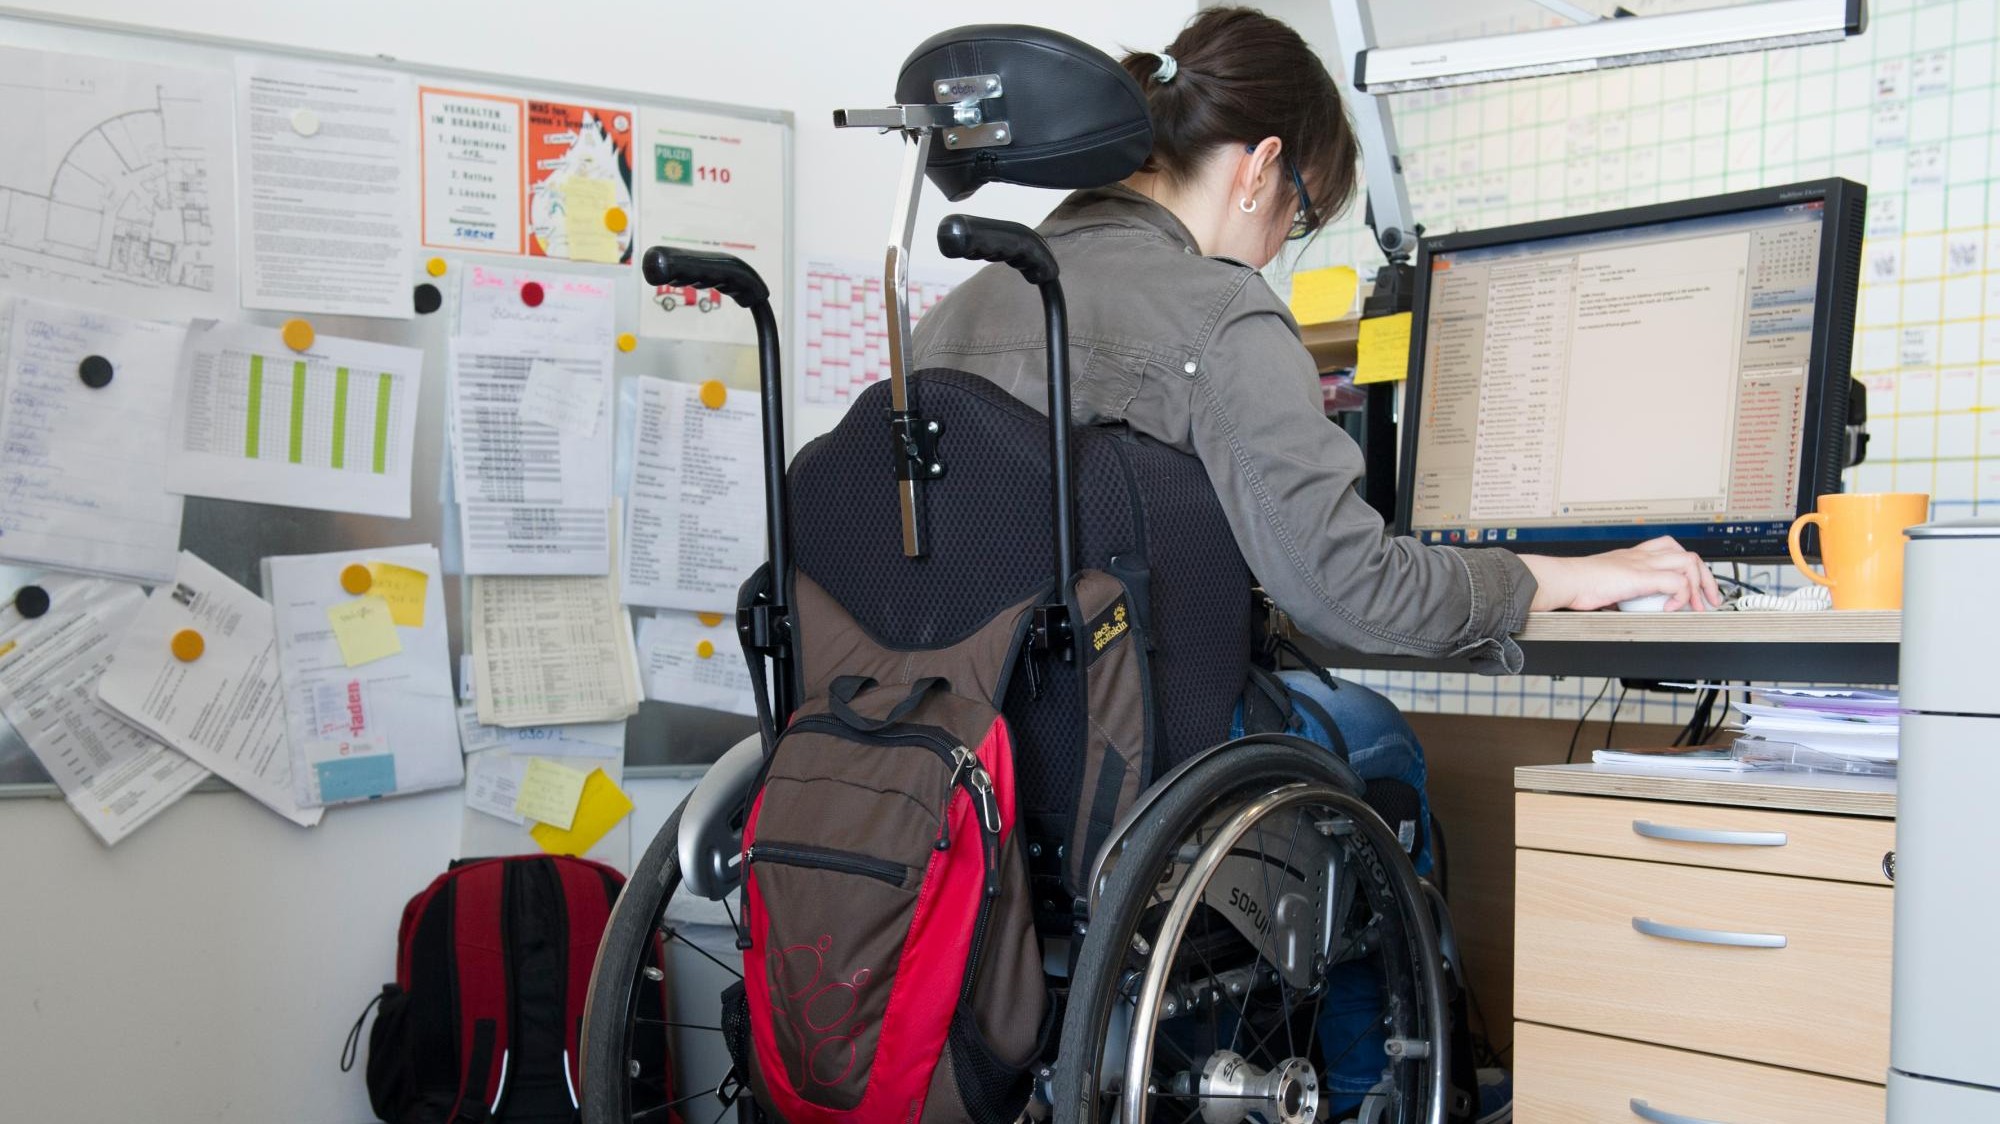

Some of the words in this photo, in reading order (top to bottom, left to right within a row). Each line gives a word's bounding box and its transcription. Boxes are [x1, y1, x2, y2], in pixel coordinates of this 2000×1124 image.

[443, 103, 500, 118] VERHALTEN
[431, 114, 444, 125] IM
[452, 134, 506, 151] Alarmieren
[656, 147, 691, 161] POLIZEI
[697, 165, 731, 183] 110
[453, 226, 495, 240] SIRENE
[1093, 622, 1112, 643] Jack
[1093, 621, 1129, 651] Wolfskin
[1351, 831, 1395, 899] ERGY
